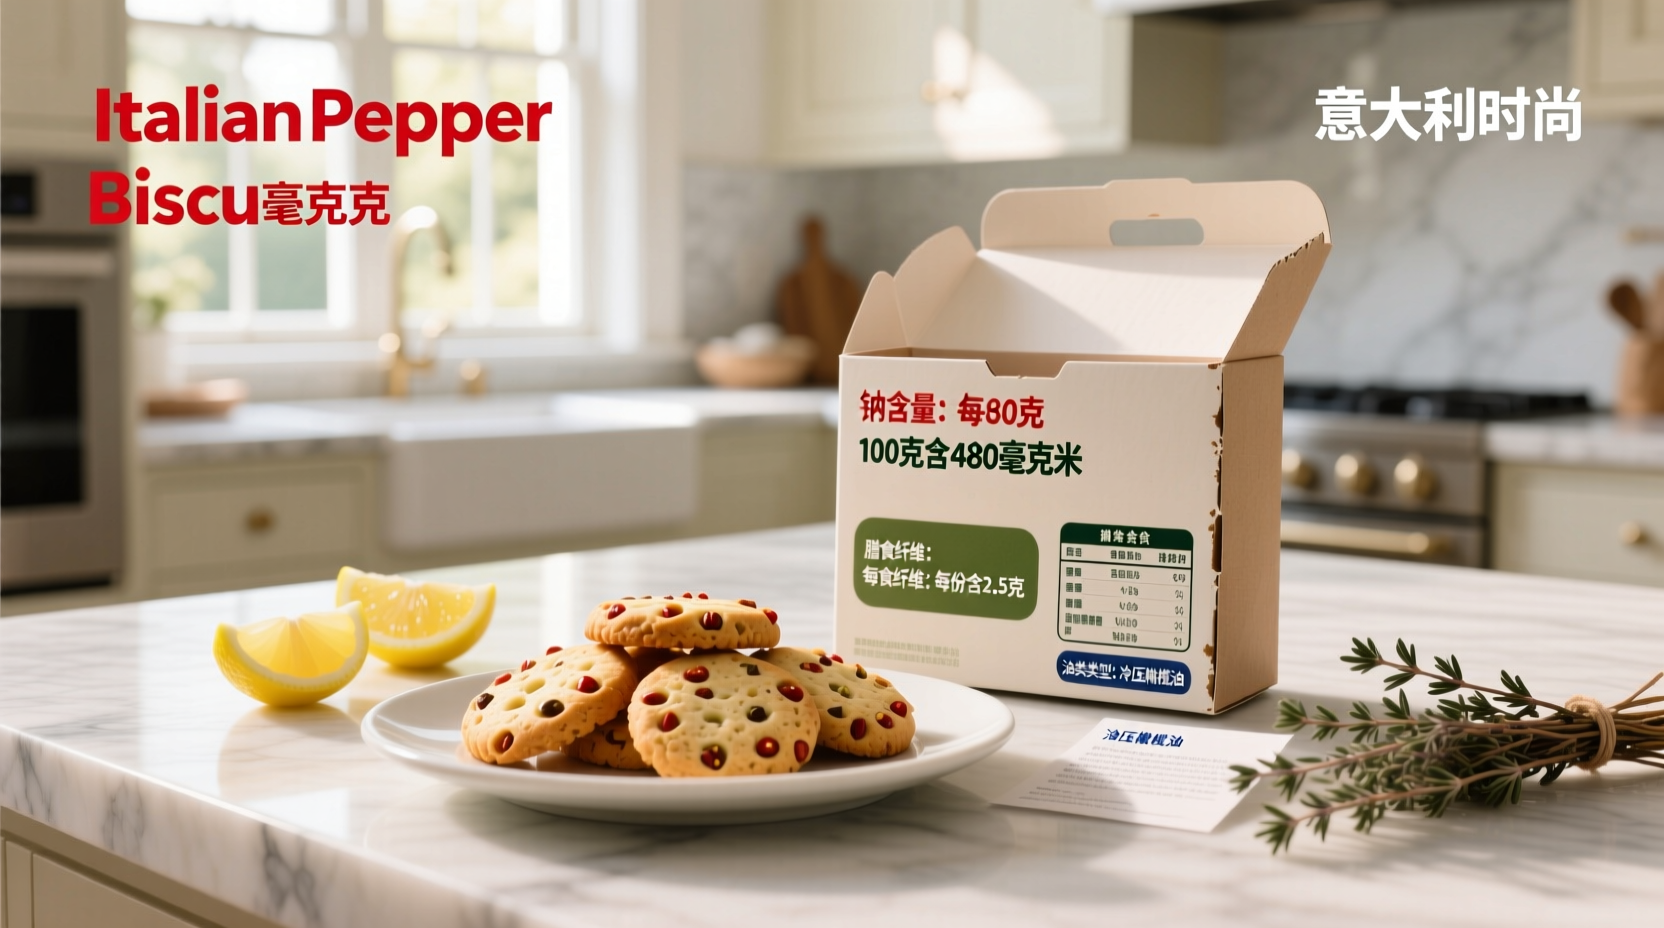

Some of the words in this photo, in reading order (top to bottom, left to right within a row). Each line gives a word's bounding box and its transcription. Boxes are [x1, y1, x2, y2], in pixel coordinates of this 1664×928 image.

[859, 435, 1083, 478] 100克含480毫克米
